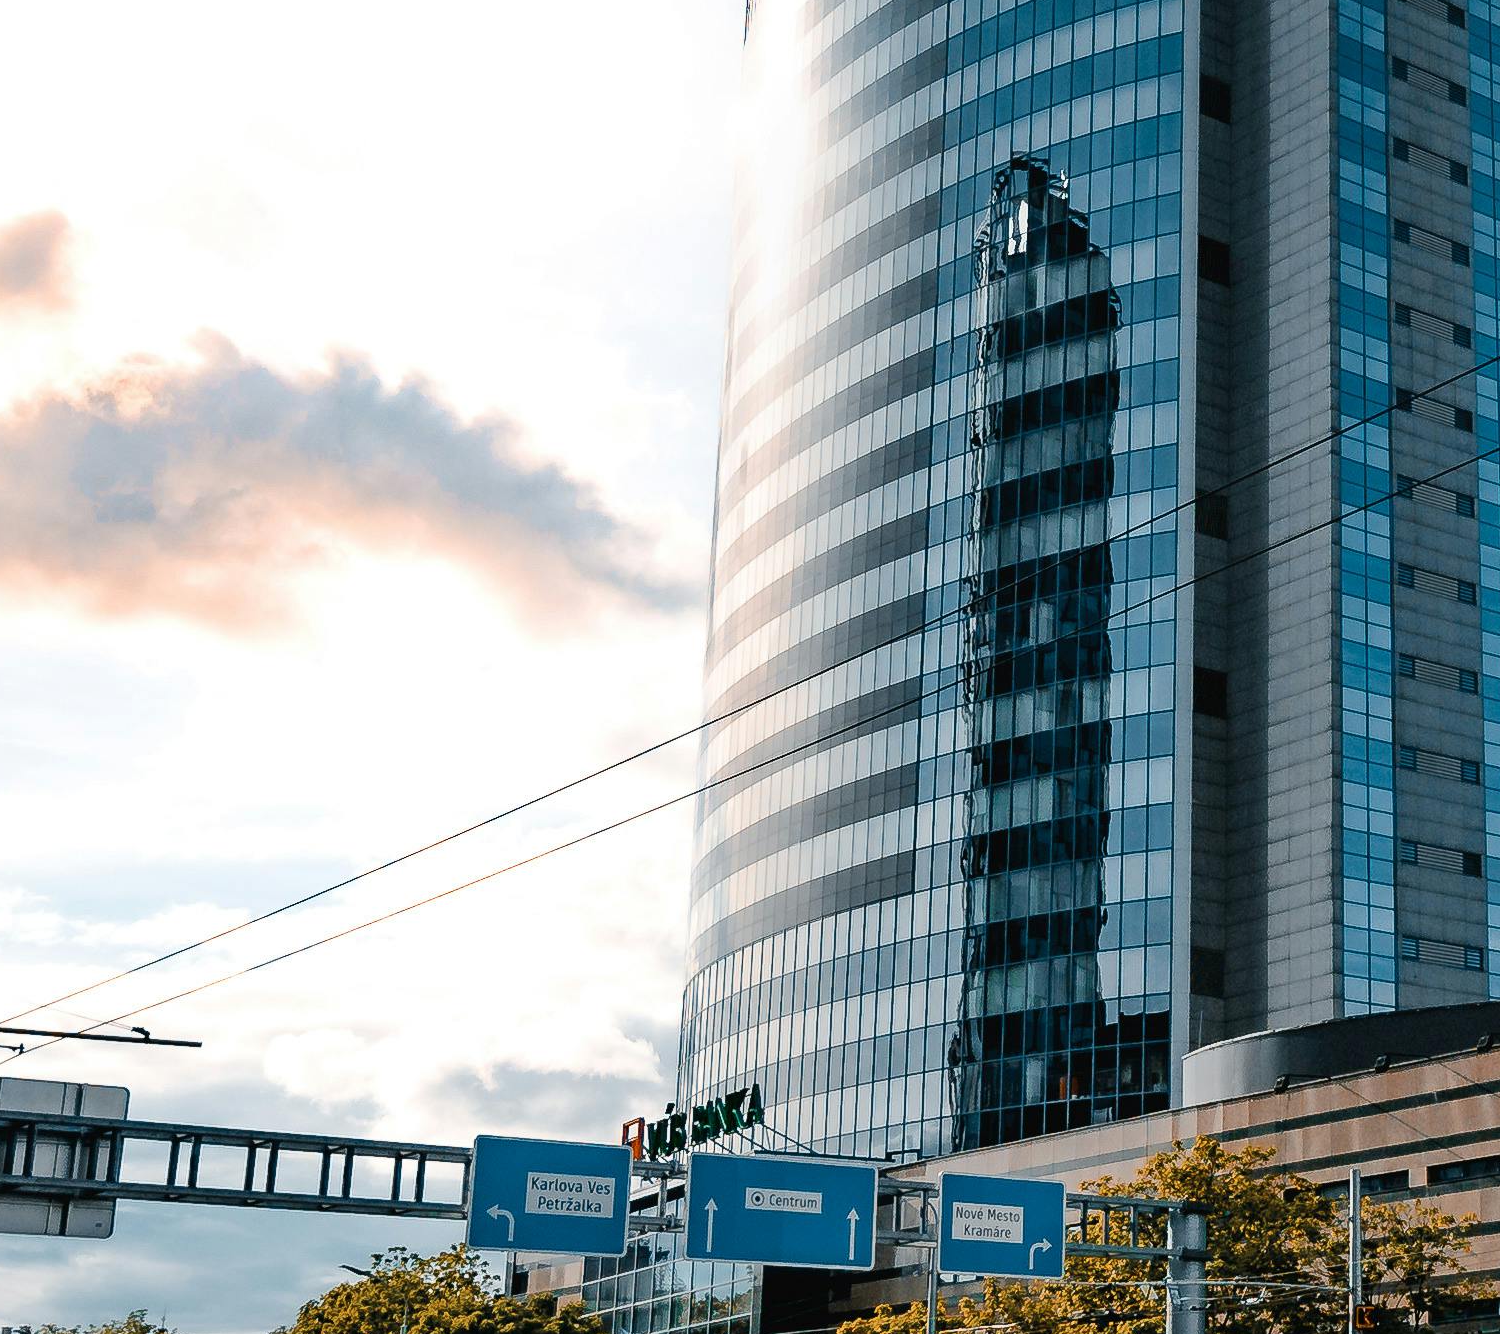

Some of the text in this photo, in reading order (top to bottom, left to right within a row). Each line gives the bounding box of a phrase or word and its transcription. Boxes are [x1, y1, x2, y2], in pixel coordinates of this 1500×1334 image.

[647, 1083, 765, 1161] VÚB BANKA
[531, 1177, 611, 1196] Karlova Ves
[538, 1196, 602, 1213] Petržalka
[769, 1194, 818, 1208] Centrum
[956, 1207, 1021, 1223] Nové Mesto
[964, 1223, 1012, 1239] Kramáre
